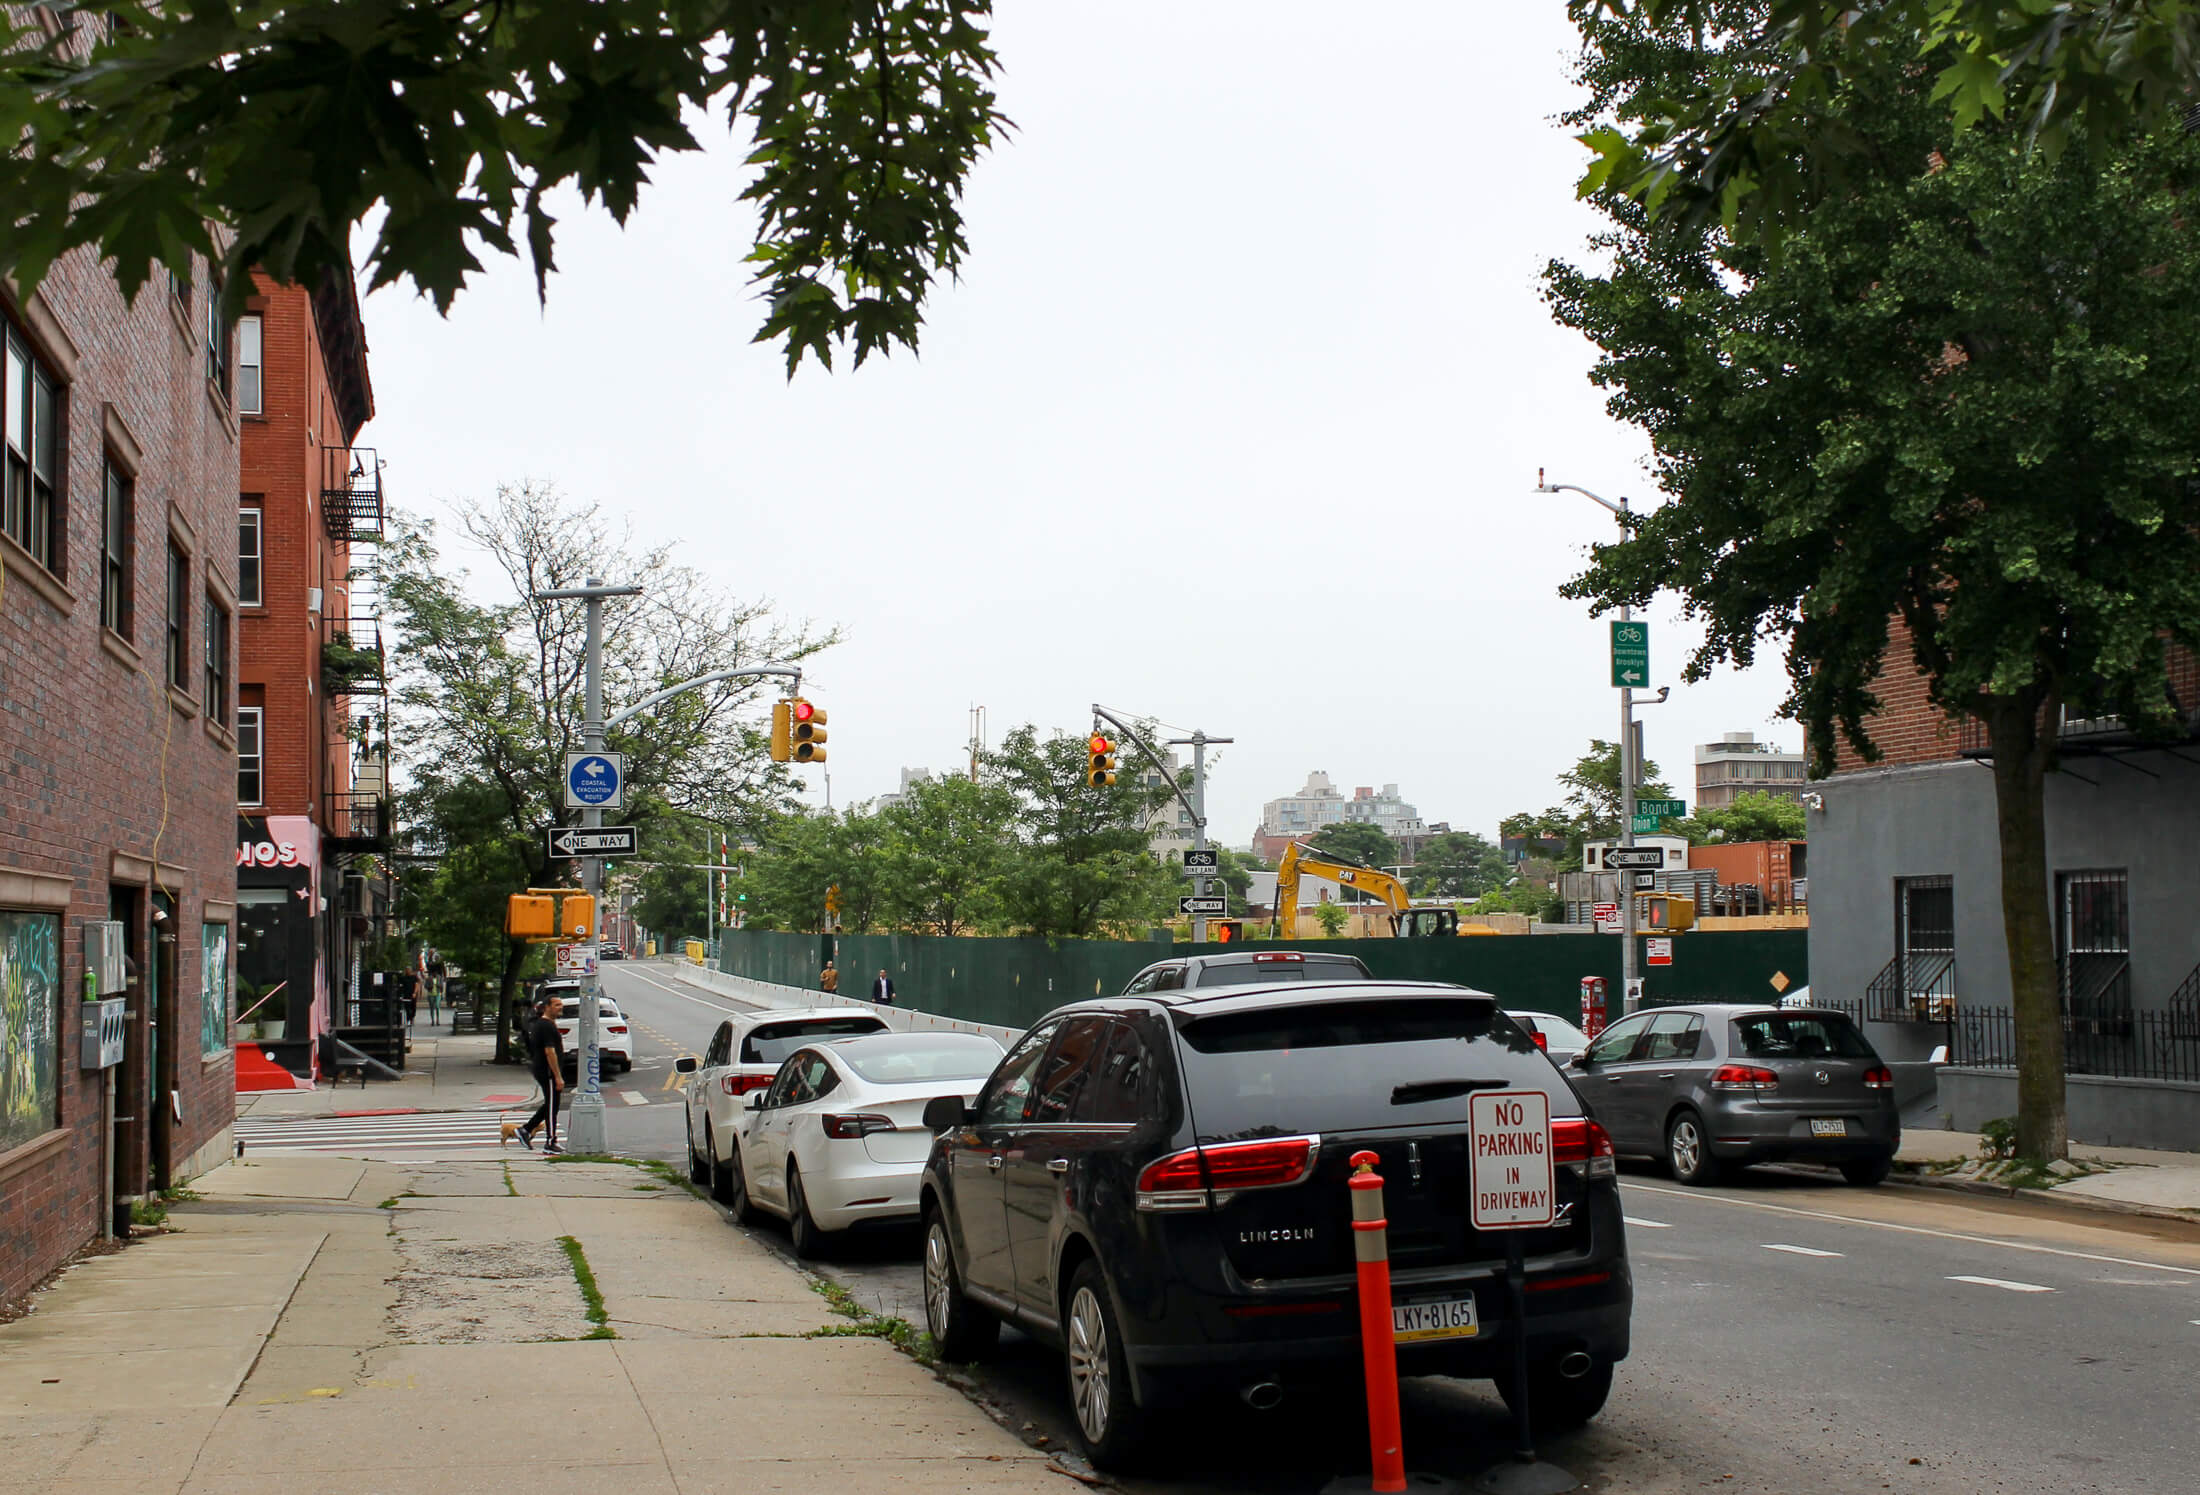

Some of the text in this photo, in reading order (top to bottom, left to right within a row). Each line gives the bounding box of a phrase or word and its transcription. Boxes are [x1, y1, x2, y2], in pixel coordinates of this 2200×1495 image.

[1616, 658, 1645, 668] Brooklyn
[1641, 801, 1669, 815] Bond
[1633, 816, 1651, 831] Union
[563, 835, 625, 848] ONE WAY
[1610, 853, 1658, 863] ONE WAY
[1201, 866, 1216, 874] LANE
[1339, 870, 1355, 882] CAT
[1495, 1103, 1524, 1127] NO
[1478, 1131, 1544, 1157] PARKING
[1506, 1167, 1520, 1185] IN
[1480, 1190, 1547, 1211] DRIVEWAY
[1239, 1227, 1314, 1243] LINCOLN
